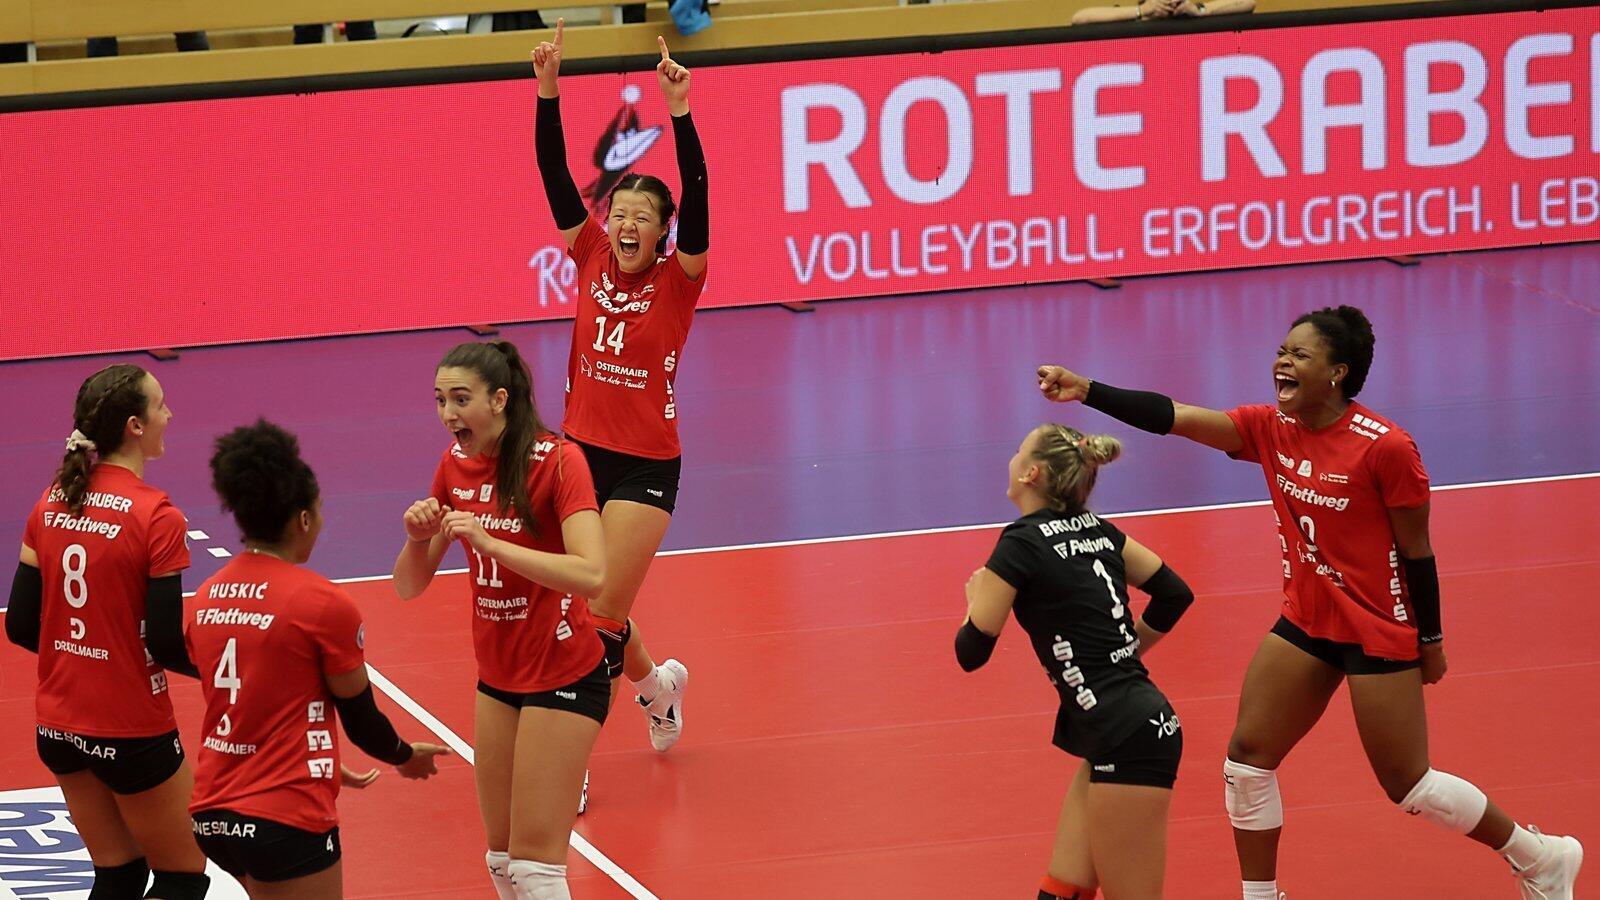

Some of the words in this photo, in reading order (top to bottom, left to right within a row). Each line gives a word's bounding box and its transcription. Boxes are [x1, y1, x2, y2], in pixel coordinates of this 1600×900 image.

[781, 63, 1145, 212] ROTE
[786, 216, 1123, 285] VOLLEYBALL.
[1142, 186, 1492, 257] ERFOLGREICH.
[592, 316, 626, 356] 14
[596, 361, 649, 378] OSTERMAIER
[1283, 481, 1350, 511] Flottweg
[53, 512, 122, 540] Flottweg
[62, 543, 88, 609] 8
[208, 581, 269, 600] HUSKIĆ
[1092, 558, 1124, 620] 1
[203, 608, 275, 630] Flottweg
[213, 637, 242, 705] 4
